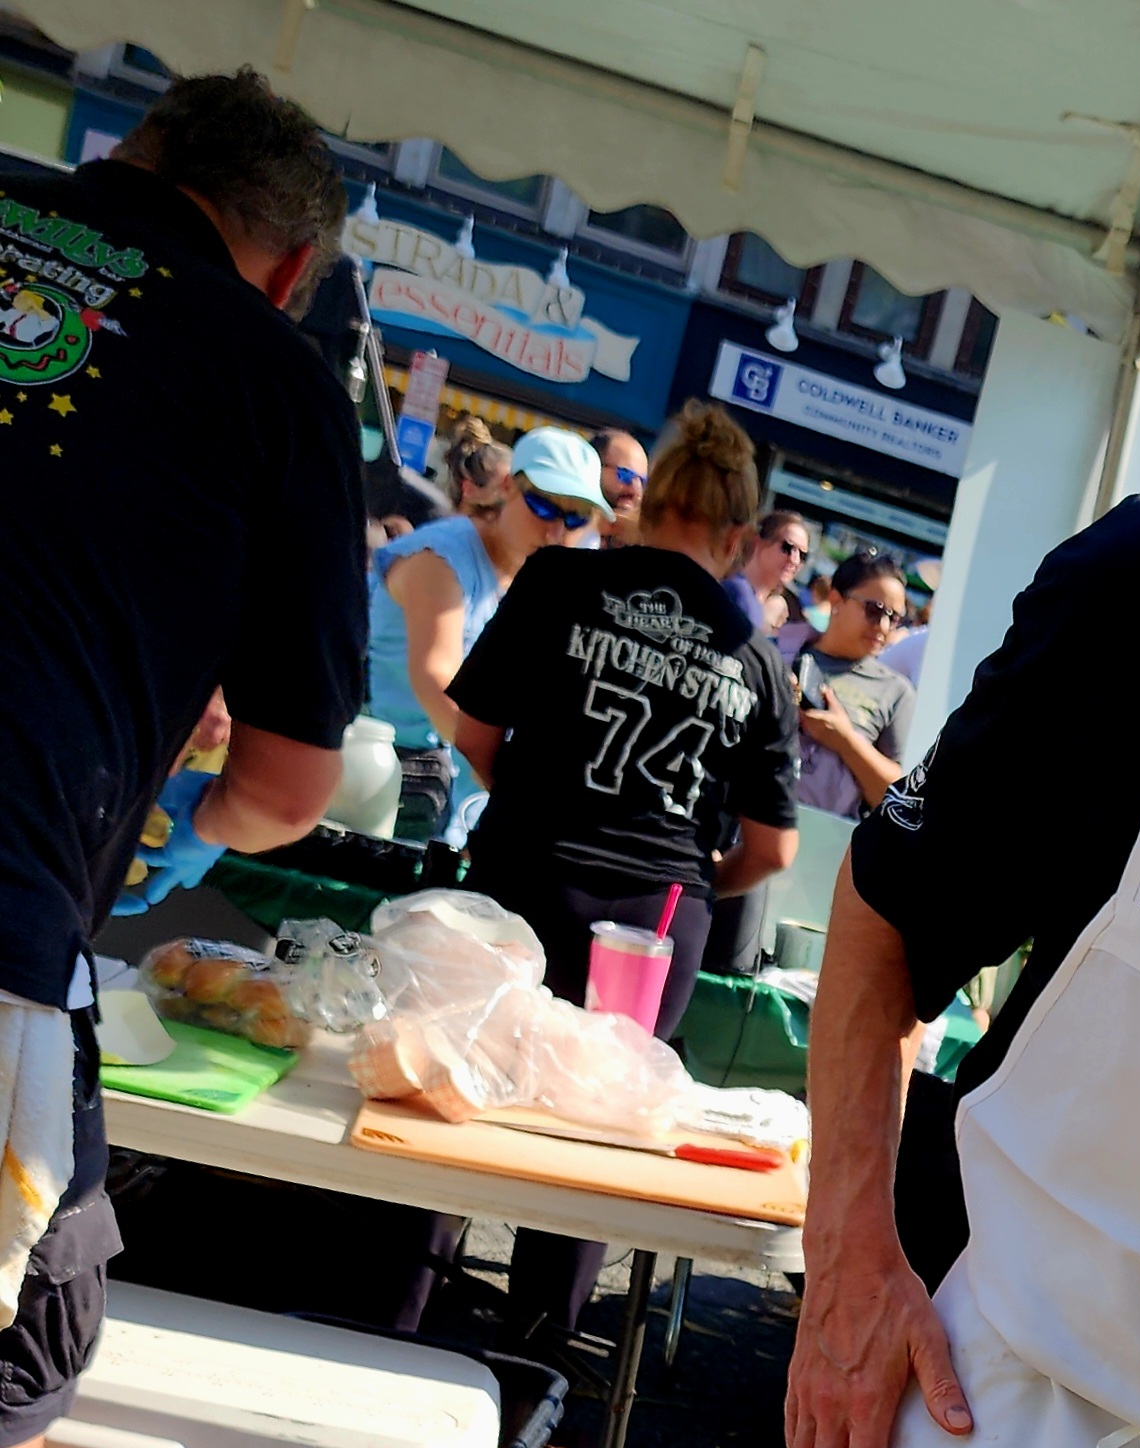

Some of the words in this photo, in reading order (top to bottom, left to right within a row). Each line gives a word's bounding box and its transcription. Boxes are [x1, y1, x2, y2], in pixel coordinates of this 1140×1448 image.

[0, 243, 118, 309] rating
[350, 223, 523, 306] STRADA
[546, 287, 574, 326] &
[377, 283, 583, 376] essentials
[797, 378, 886, 421] COLDWELL
[892, 410, 959, 445] BANKER
[638, 601, 667, 615] THE
[566, 622, 682, 691] KITCHEN
[583, 678, 716, 820] 74
